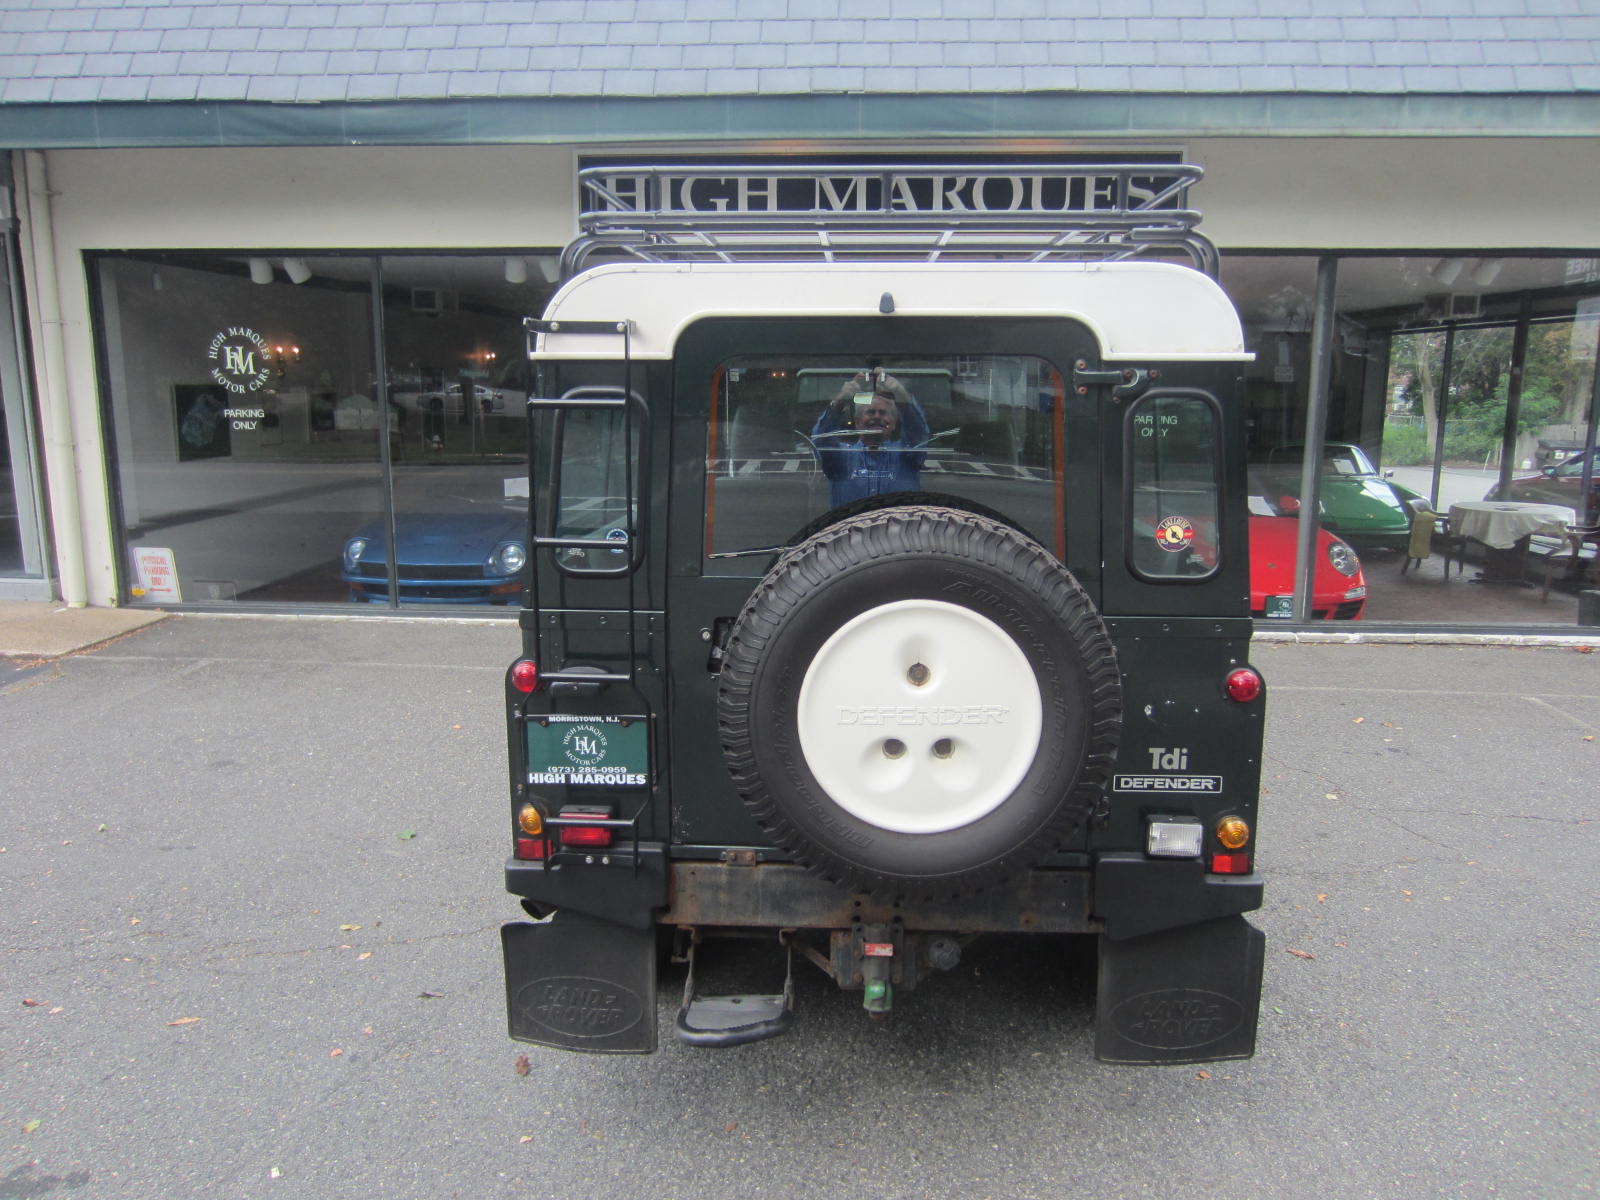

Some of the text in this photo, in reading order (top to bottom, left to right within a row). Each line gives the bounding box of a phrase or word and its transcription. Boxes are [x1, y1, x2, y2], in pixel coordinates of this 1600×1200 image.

[606, 175, 779, 212] HIGH
[209, 326, 272, 360] HIGH MARQUES
[211, 367, 271, 394] MOTOR CARS
[224, 409, 265, 418] PARKING
[1134, 415, 1178, 425] PARING
[232, 421, 257, 430] ONLY
[837, 704, 1010, 726] DEFENDER
[563, 724, 608, 746] HIGH MARQUES
[565, 749, 608, 766] MOTOR CARS
[1148, 747, 1188, 770] Tdi
[578, 766, 627, 774] 285-0959
[529, 773, 647, 785] HIGH MARQUES
[1120, 777, 1215, 790] DEFENDER
